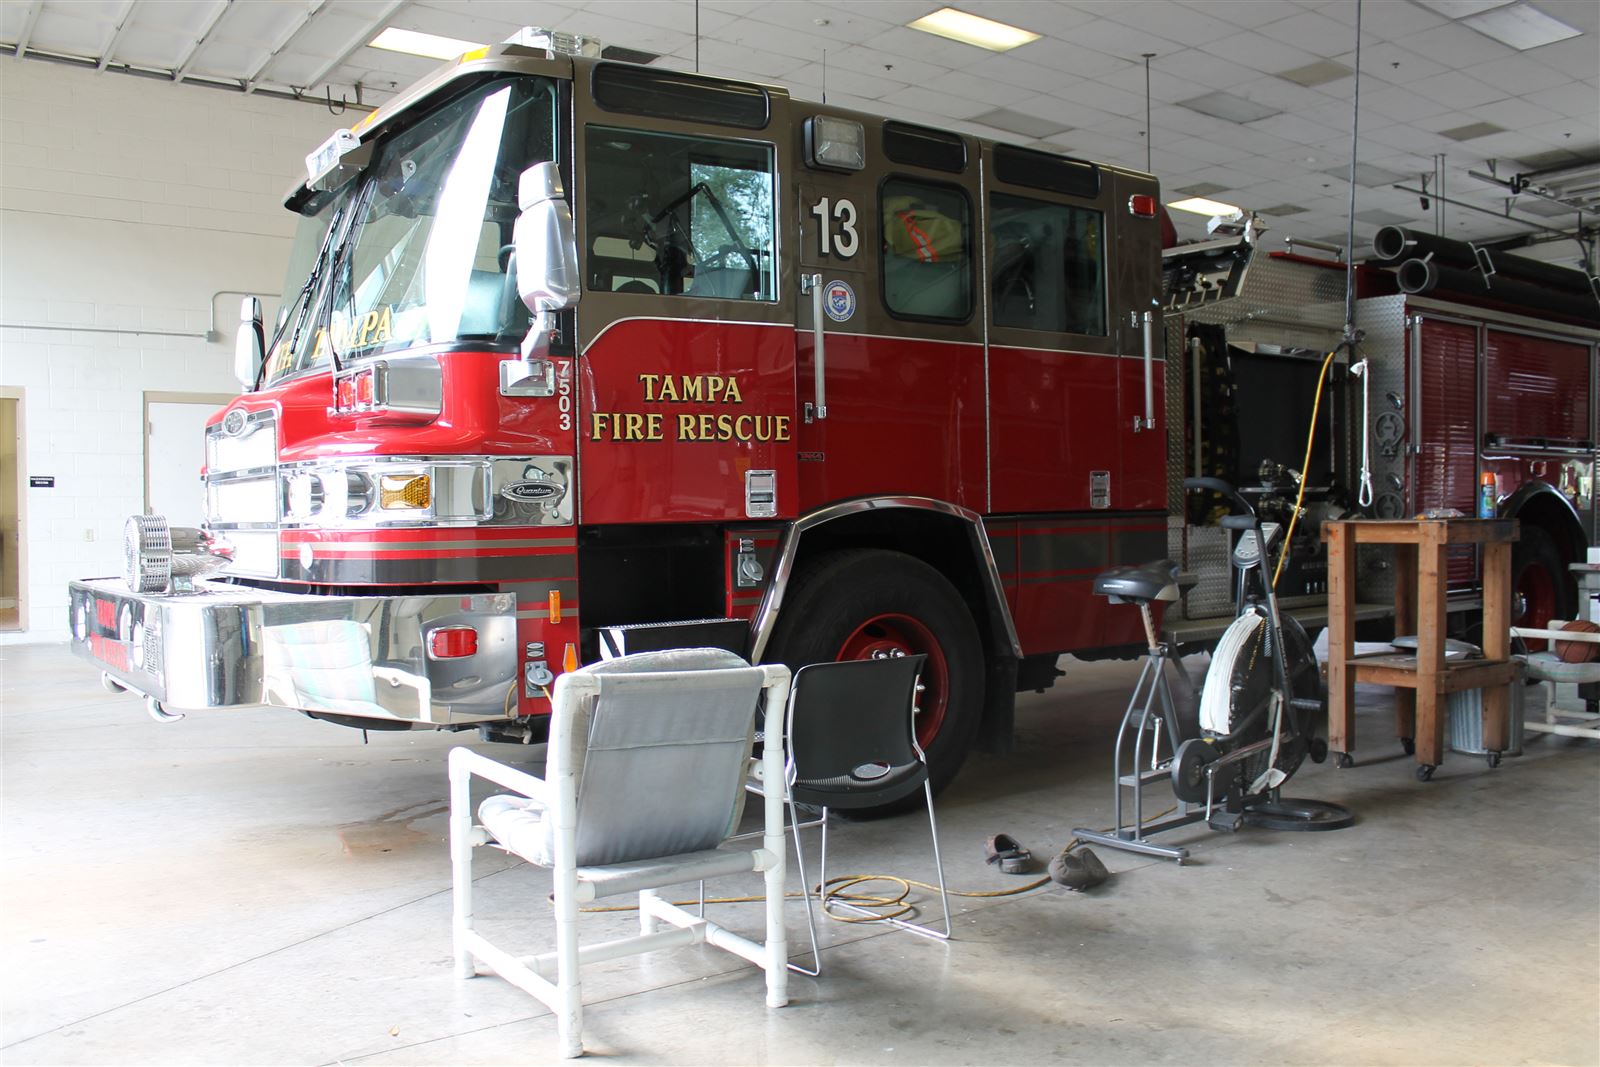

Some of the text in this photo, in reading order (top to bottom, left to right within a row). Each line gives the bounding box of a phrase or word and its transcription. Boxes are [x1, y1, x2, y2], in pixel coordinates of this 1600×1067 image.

[812, 196, 859, 258] 13
[558, 360, 571, 431] 7503
[639, 374, 743, 403] TAMPA
[591, 413, 791, 442] FIRE RESCUE
[516, 485, 552, 495] Quantum
